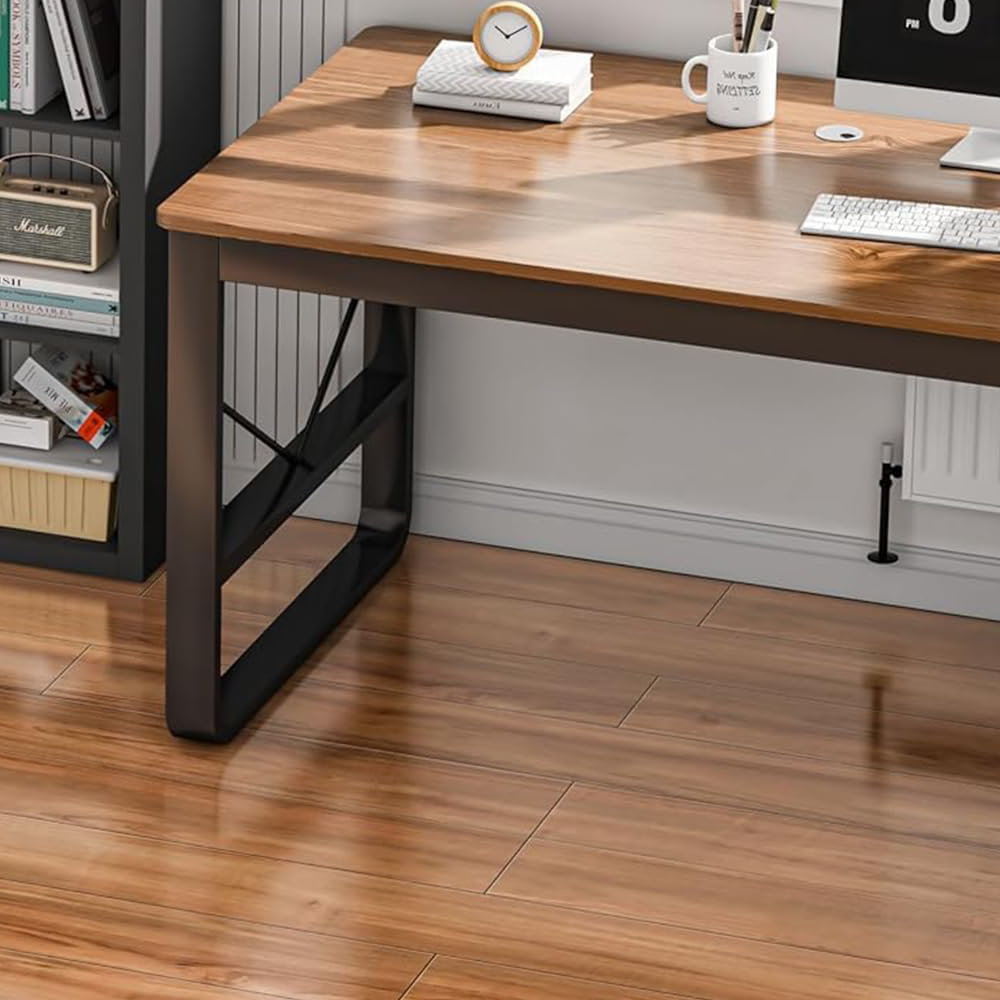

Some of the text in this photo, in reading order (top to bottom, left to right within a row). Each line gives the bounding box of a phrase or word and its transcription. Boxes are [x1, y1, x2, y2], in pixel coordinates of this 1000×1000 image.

[905, 18, 920, 30] PM
[12, 33, 21, 89] SYMBOLS
[13, 218, 66, 237] Marshall
